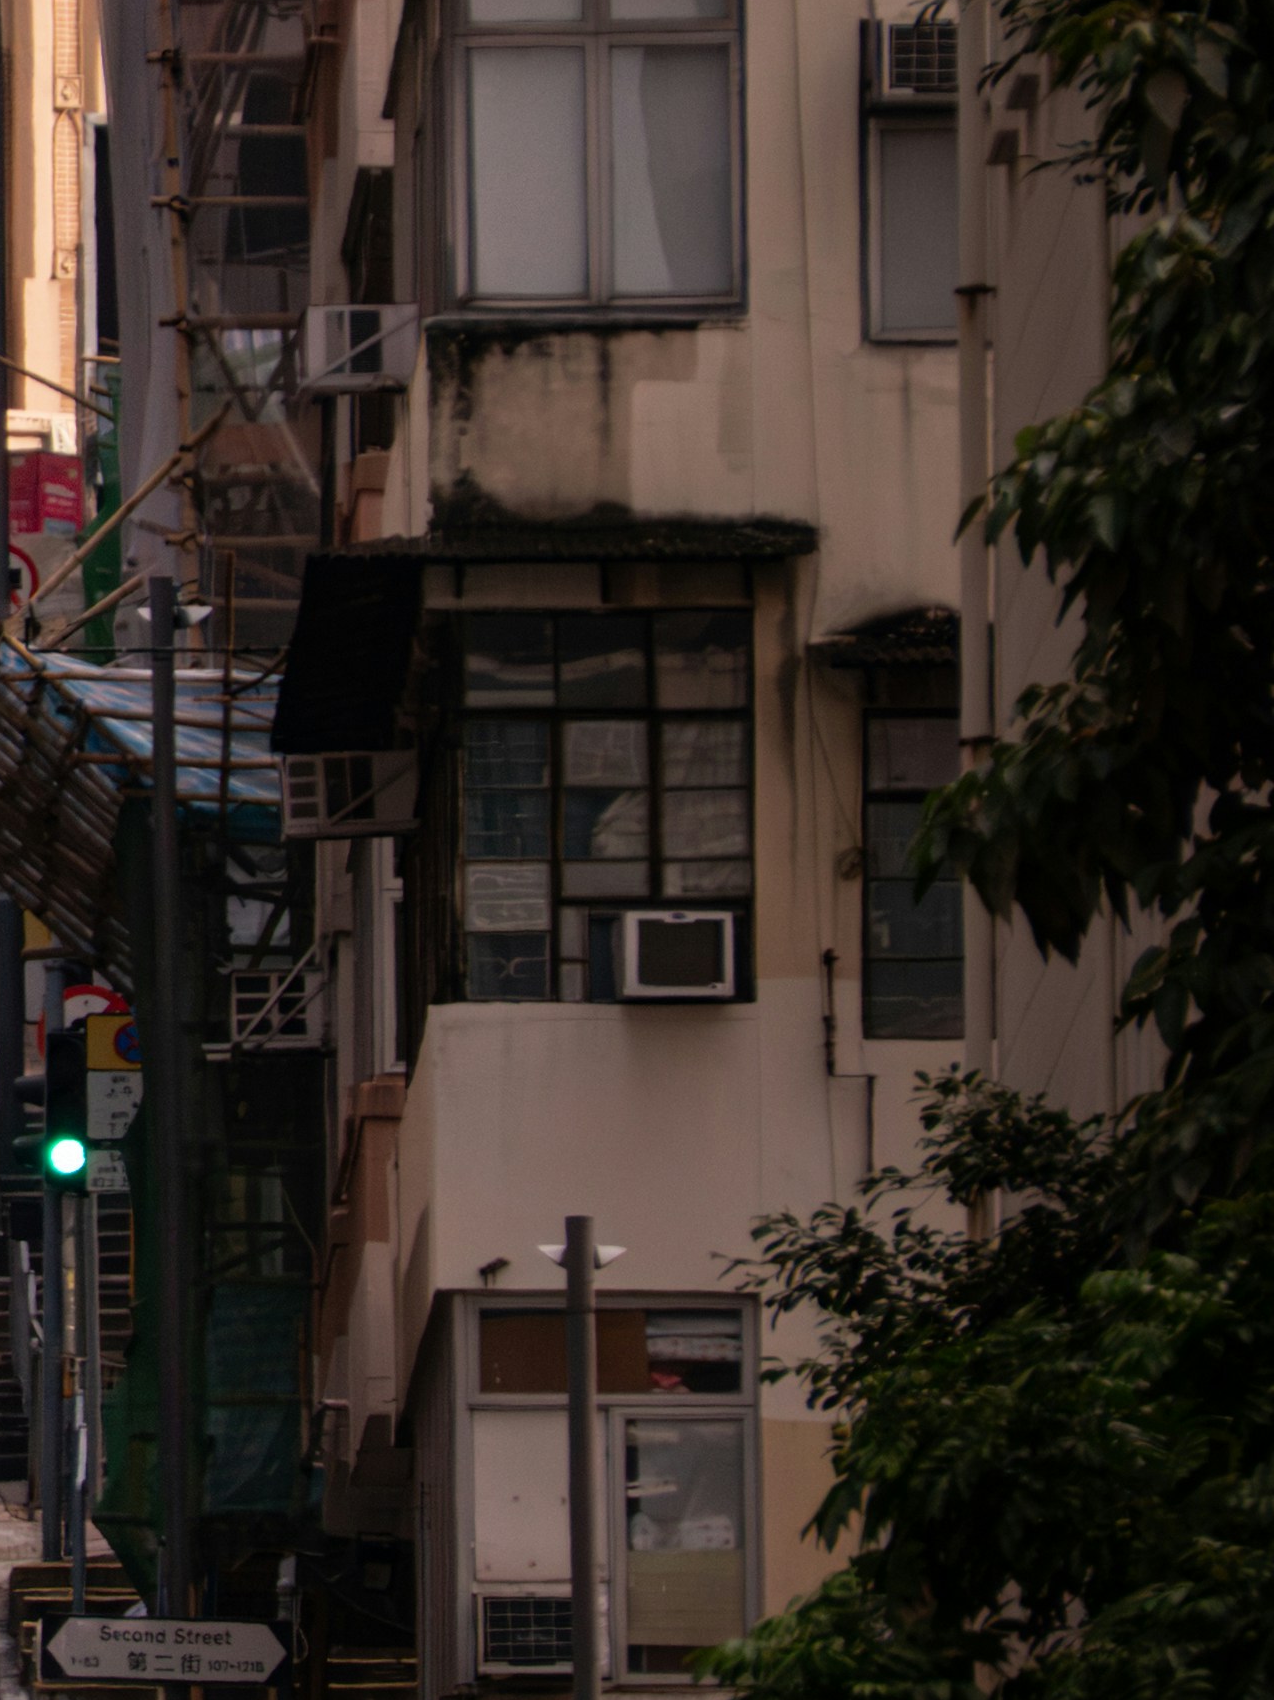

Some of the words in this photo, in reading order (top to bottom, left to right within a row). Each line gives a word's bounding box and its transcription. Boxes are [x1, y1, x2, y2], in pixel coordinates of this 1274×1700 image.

[99, 1625, 167, 1645] Second
[173, 1627, 233, 1648] Street
[126, 1651, 202, 1676] 第二街
